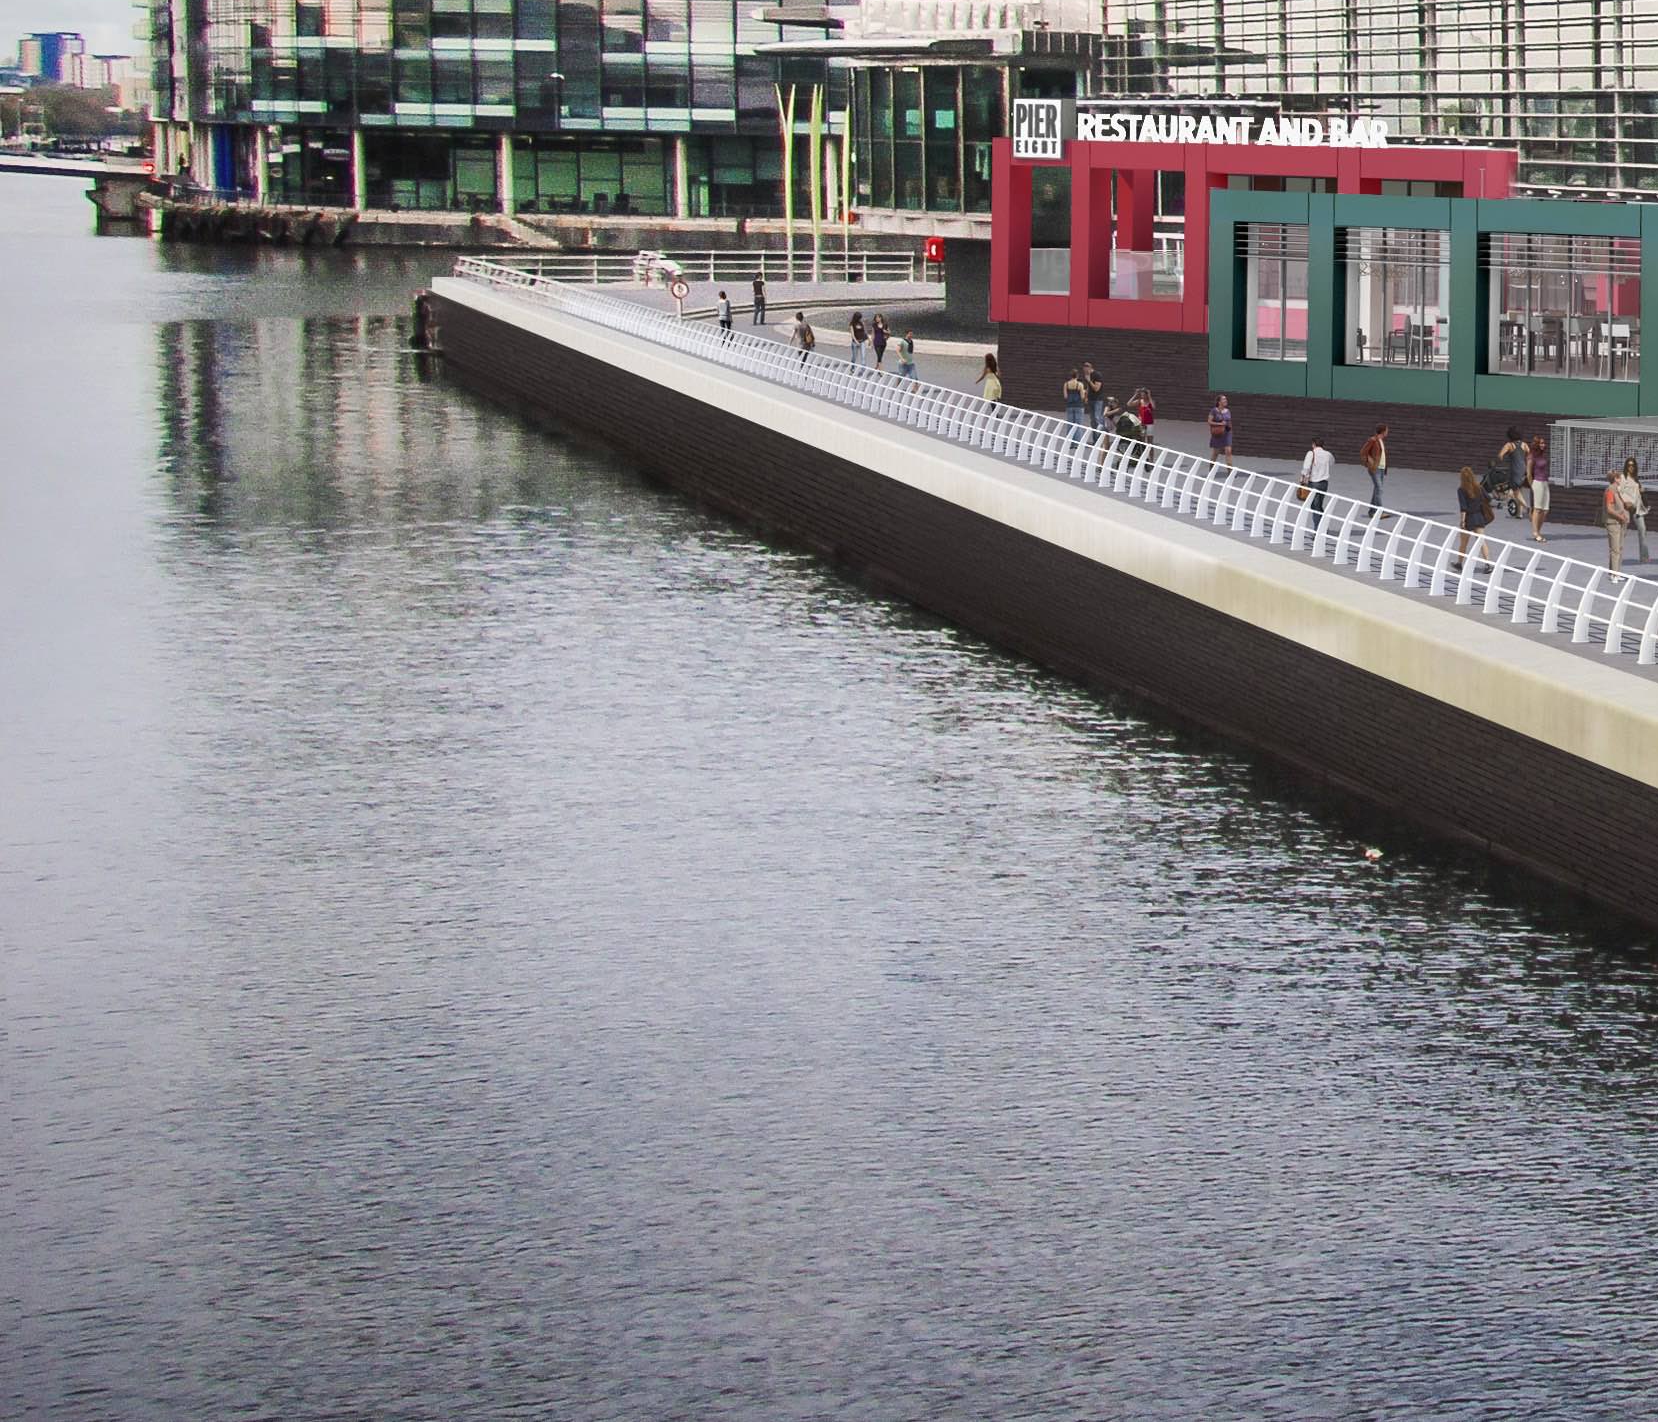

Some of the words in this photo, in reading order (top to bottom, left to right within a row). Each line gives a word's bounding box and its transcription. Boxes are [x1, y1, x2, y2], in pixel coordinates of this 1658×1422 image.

[1016, 104, 1057, 138] PIER
[1078, 113, 1254, 145] RESTAURANT
[1256, 117, 1323, 146] AND
[1329, 117, 1389, 148] BAR
[1016, 140, 1057, 154] EIGHT
